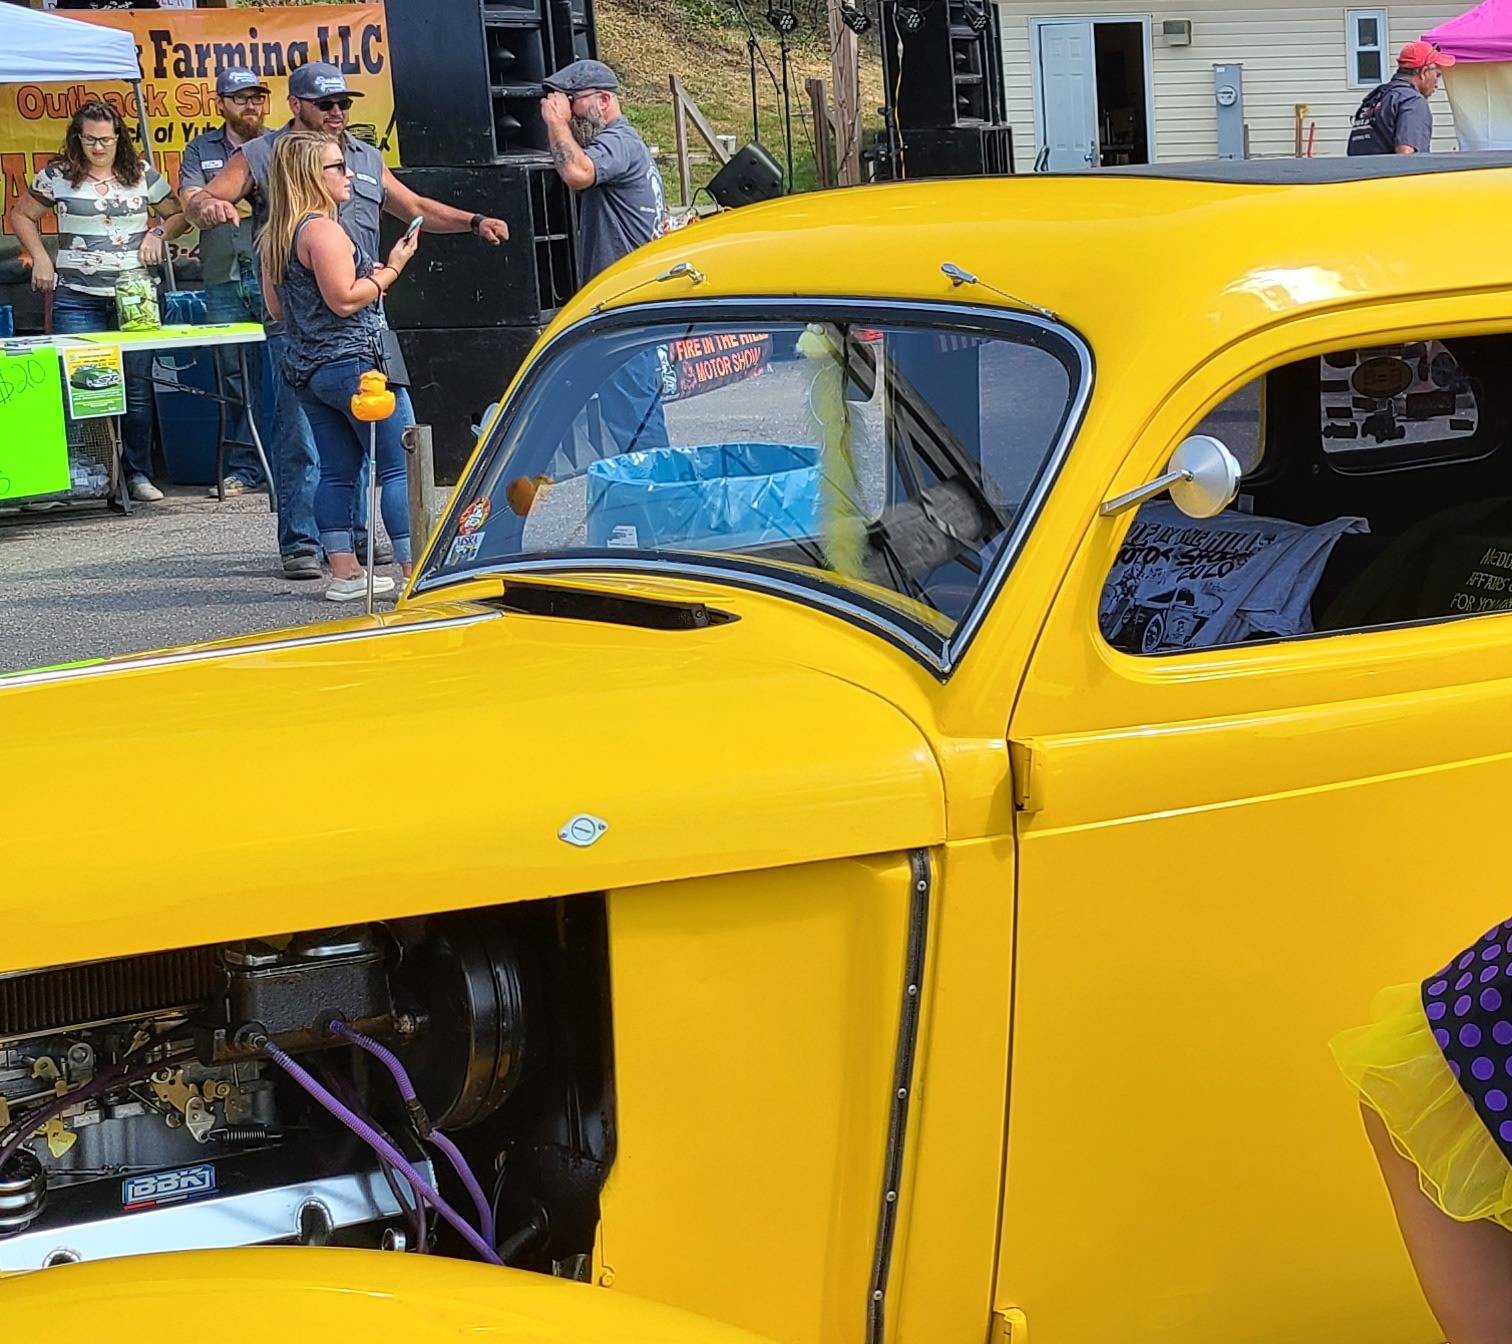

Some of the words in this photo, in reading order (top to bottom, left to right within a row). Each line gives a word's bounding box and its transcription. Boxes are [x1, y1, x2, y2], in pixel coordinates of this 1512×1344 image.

[149, 27, 308, 79] Farming
[317, 24, 385, 75] LLC
[17, 83, 169, 120] Outback
[154, 122, 174, 143] of
[675, 338, 702, 361] FIRE
[702, 336, 715, 354] IN
[716, 334, 740, 351] THE
[695, 356, 733, 382] MOTOR
[732, 347, 762, 372] SHOW
[1450, 593, 1476, 611] FOR
[133, 1167, 203, 1196] BBK
